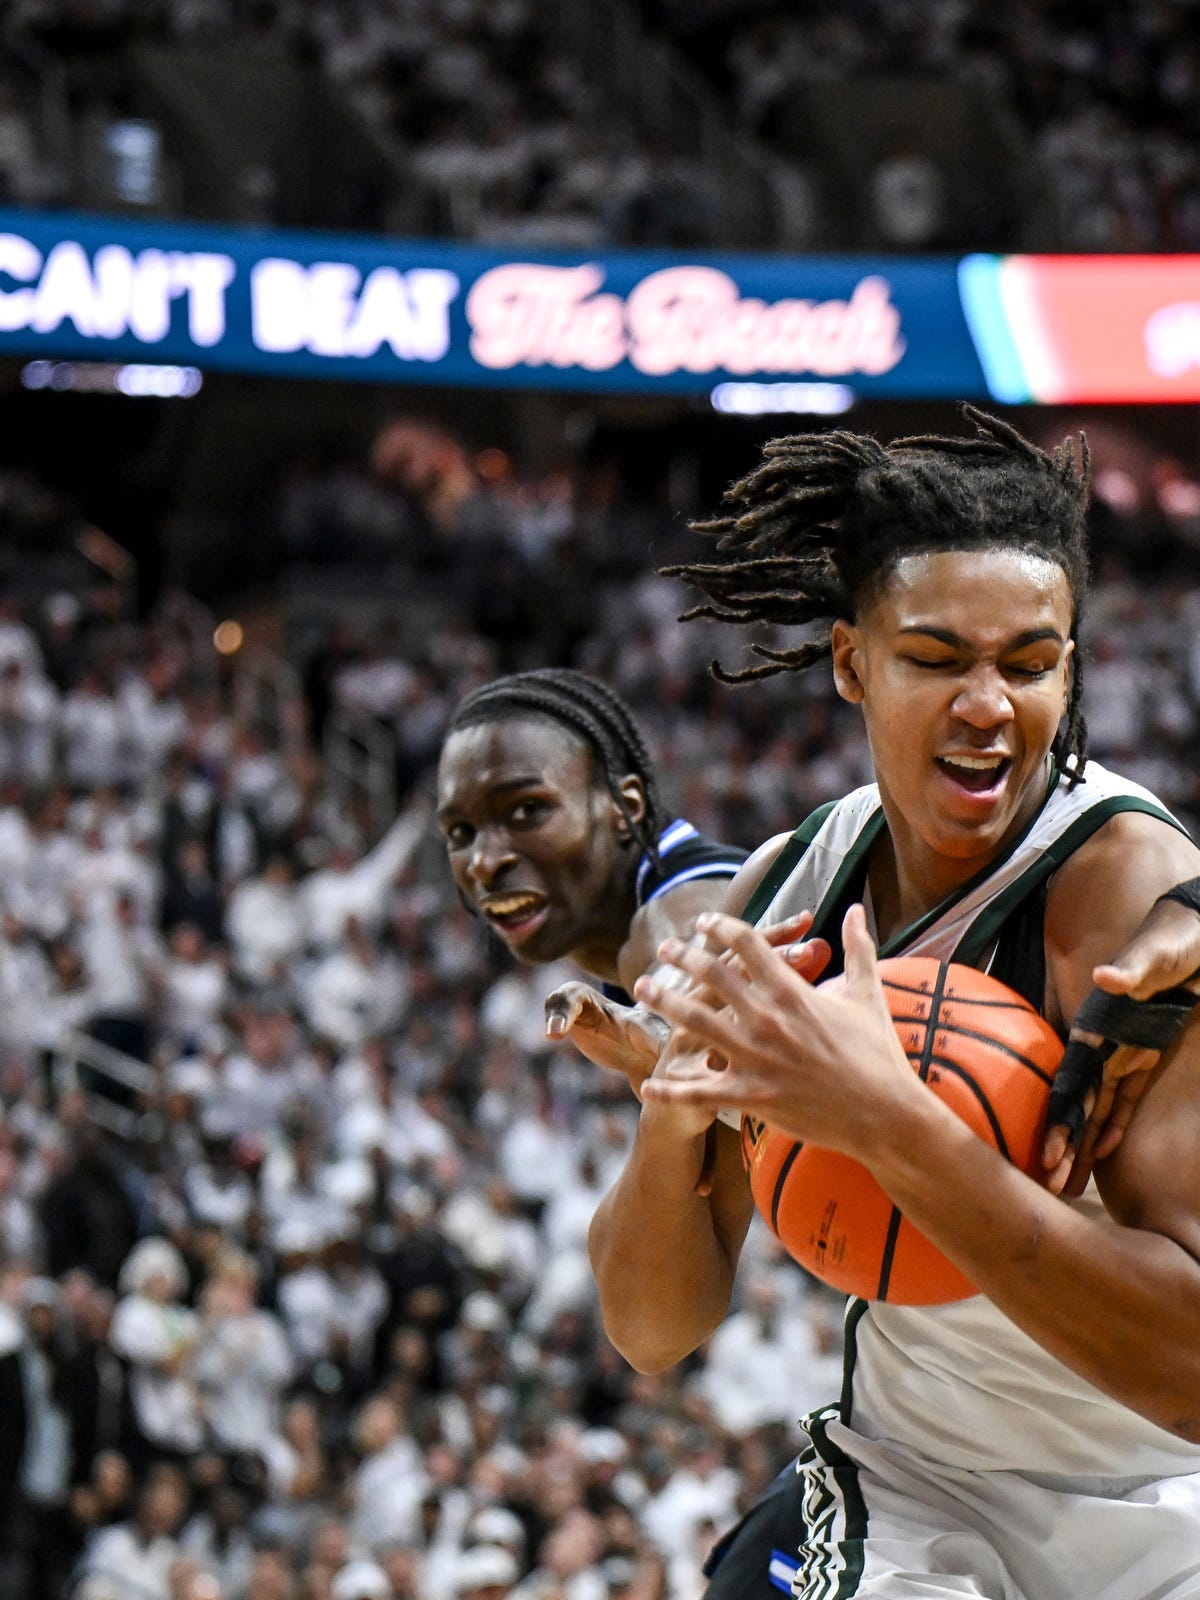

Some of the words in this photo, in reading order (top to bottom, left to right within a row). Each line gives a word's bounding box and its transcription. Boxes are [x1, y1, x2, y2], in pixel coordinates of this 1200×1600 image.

[250, 257, 459, 362] BEAT
[467, 263, 627, 369] The
[627, 266, 908, 376] Beach
